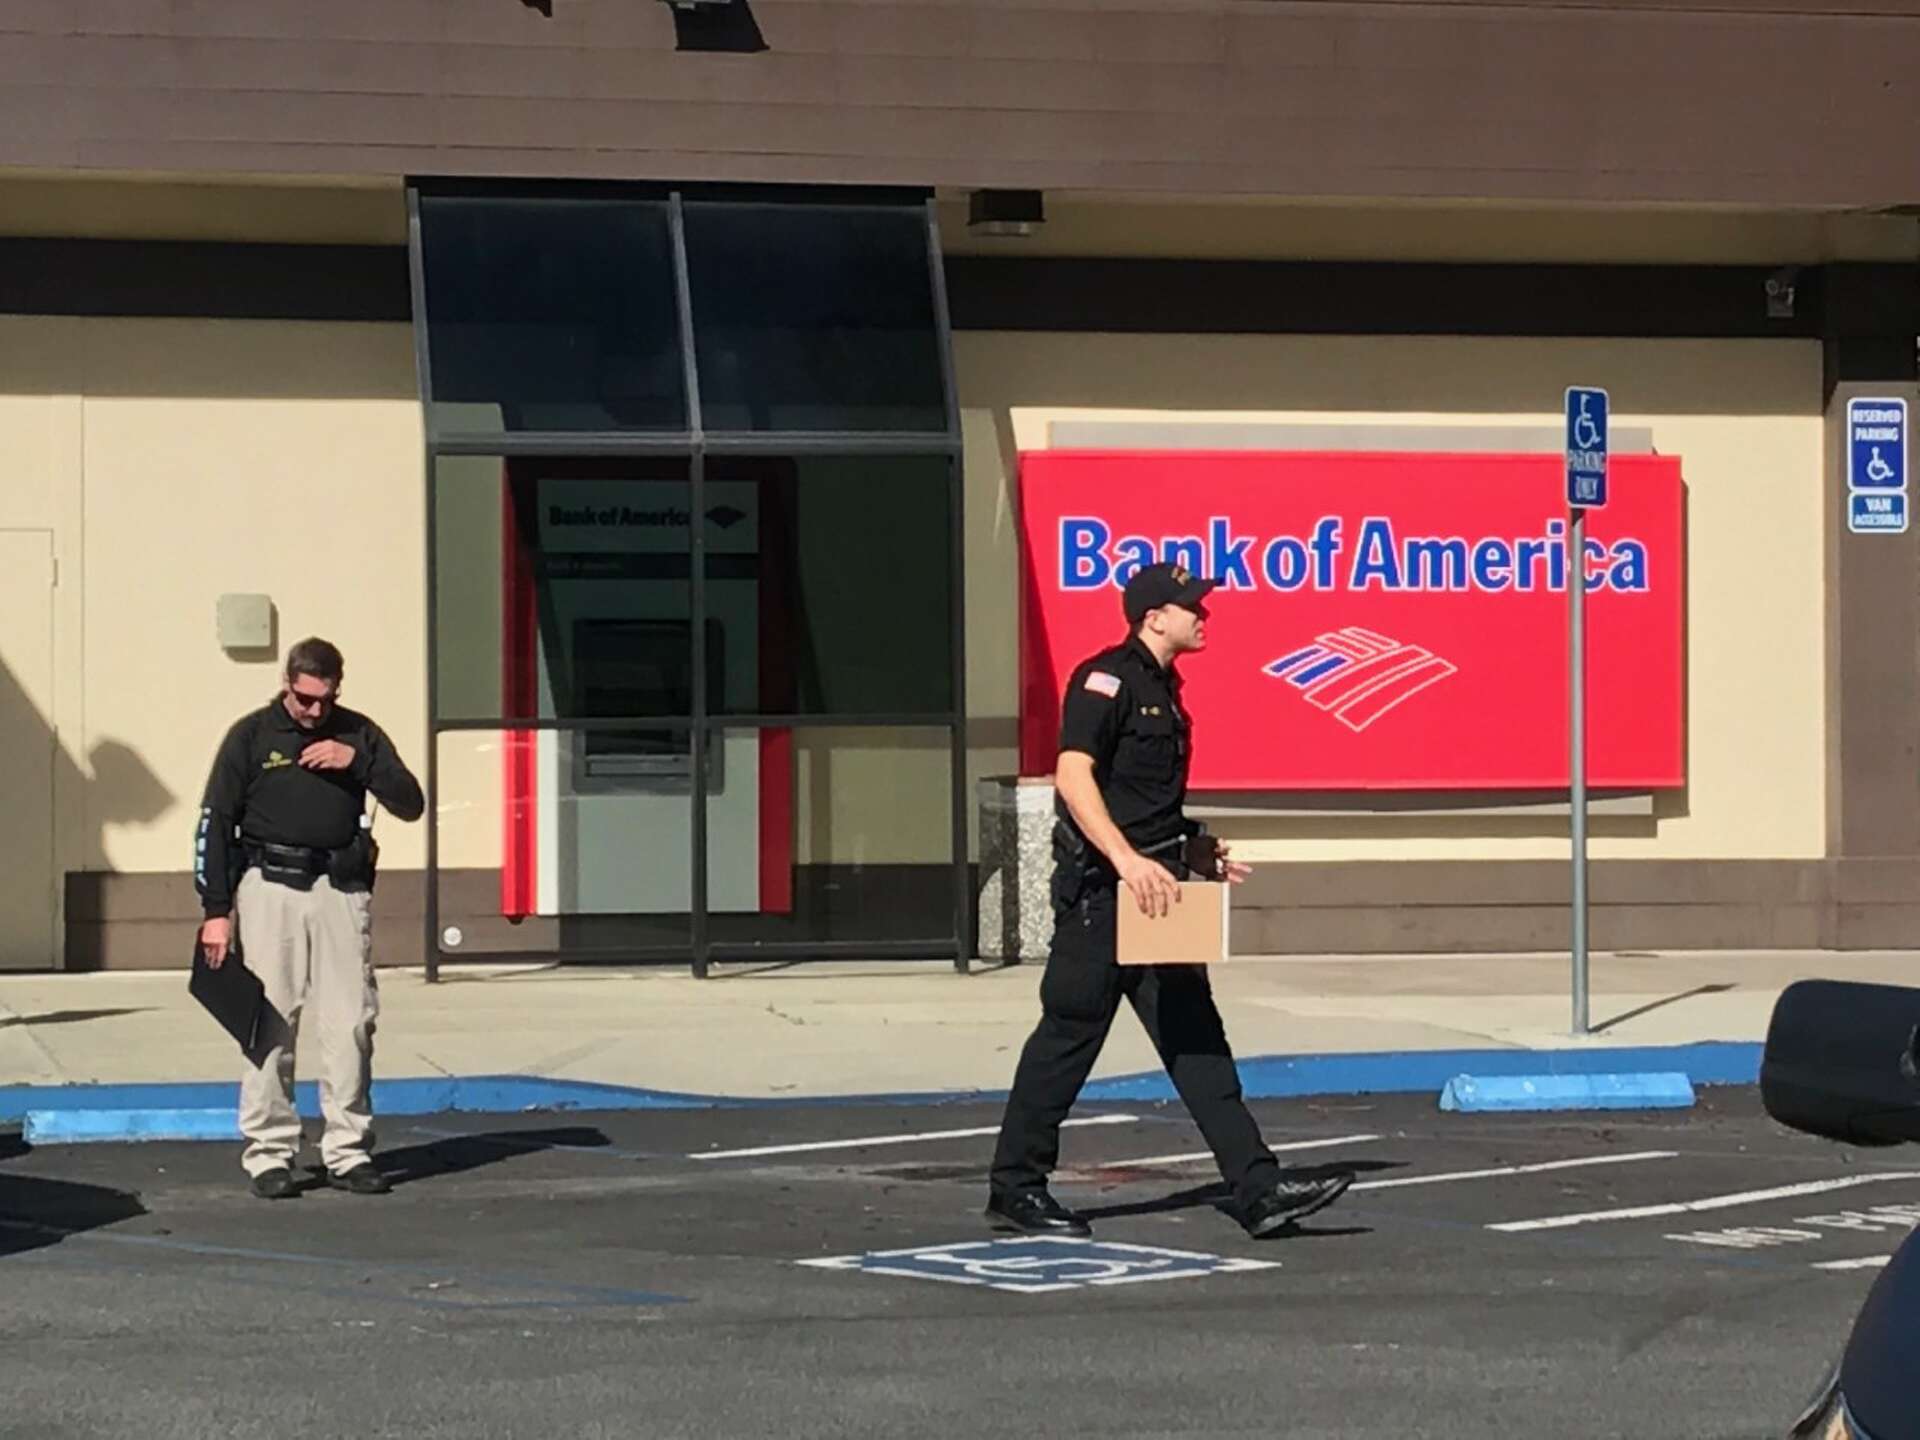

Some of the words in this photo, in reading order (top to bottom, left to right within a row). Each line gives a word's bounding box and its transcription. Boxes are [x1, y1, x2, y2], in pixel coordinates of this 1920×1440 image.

[1852, 409, 1901, 423] RESERVED
[1855, 427, 1899, 441] PARKING
[1568, 449, 1605, 473] PARKING
[1865, 497, 1892, 512] VAN
[548, 506, 597, 526] Bank
[598, 506, 619, 526] of
[1059, 516, 1256, 591] Bank
[1263, 516, 1343, 591] of
[1347, 517, 1650, 592] America
